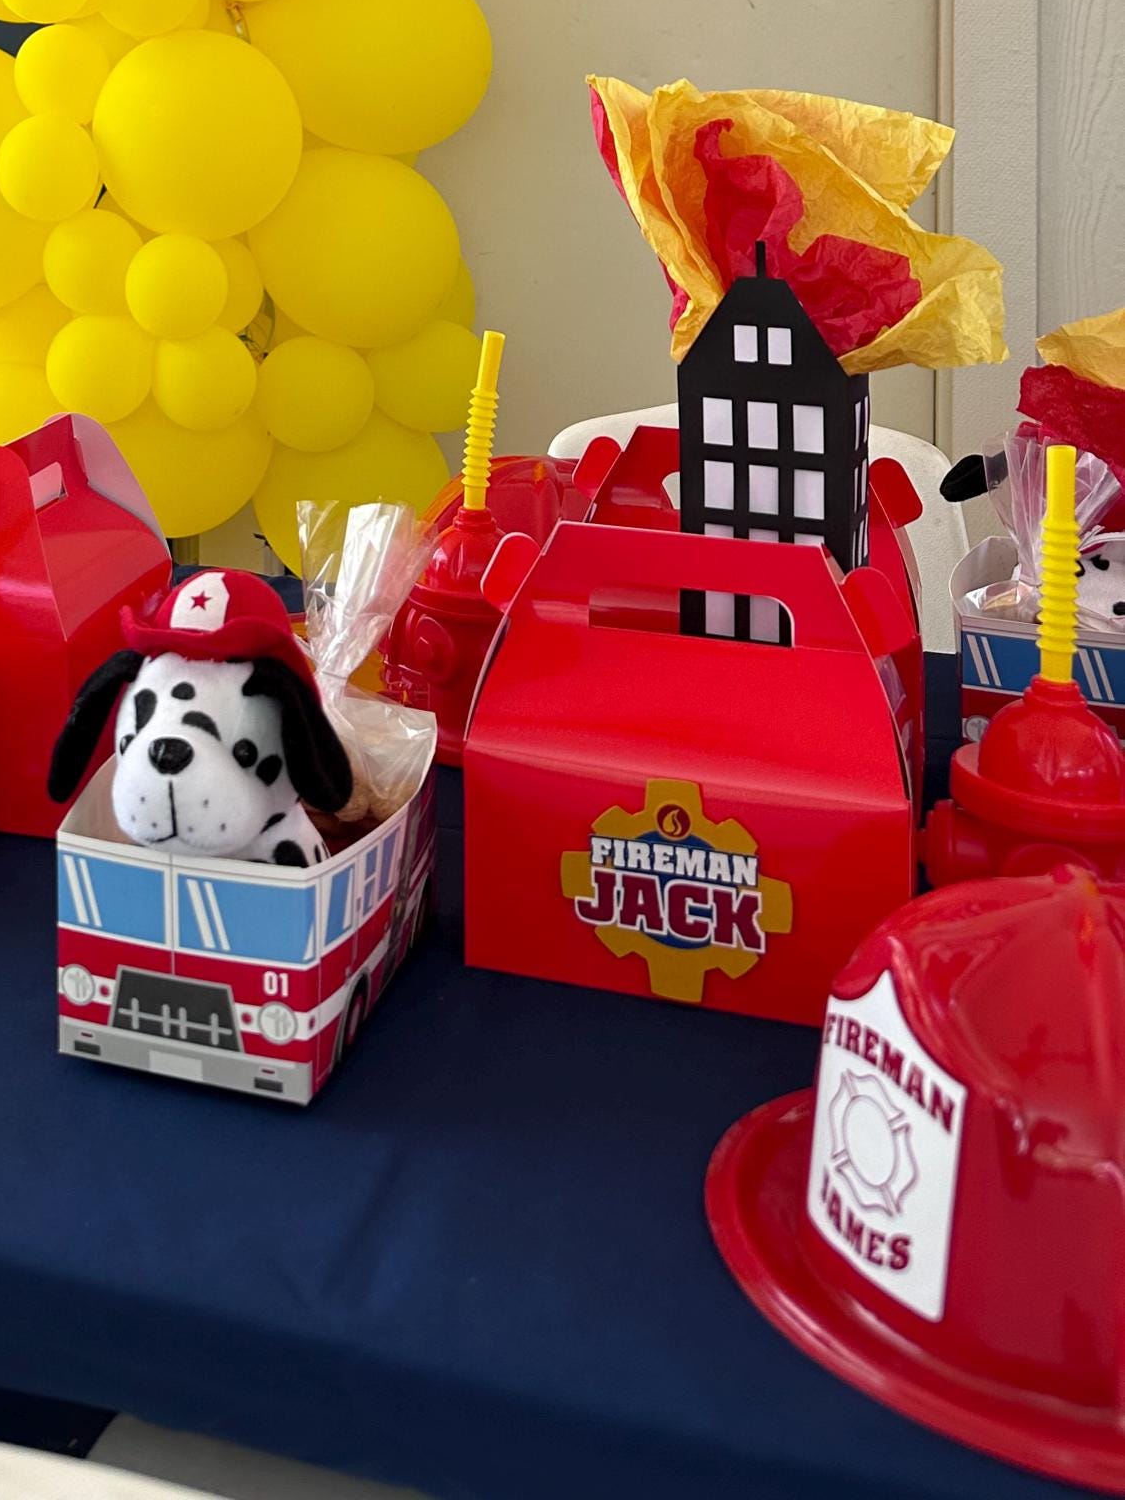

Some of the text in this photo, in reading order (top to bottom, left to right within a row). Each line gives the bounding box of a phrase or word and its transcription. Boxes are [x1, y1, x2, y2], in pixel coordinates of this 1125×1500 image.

[590, 837, 757, 886] FIREMAN
[575, 866, 765, 953] JACK
[264, 971, 289, 997] 01
[824, 1013, 955, 1134] FIREMAN
